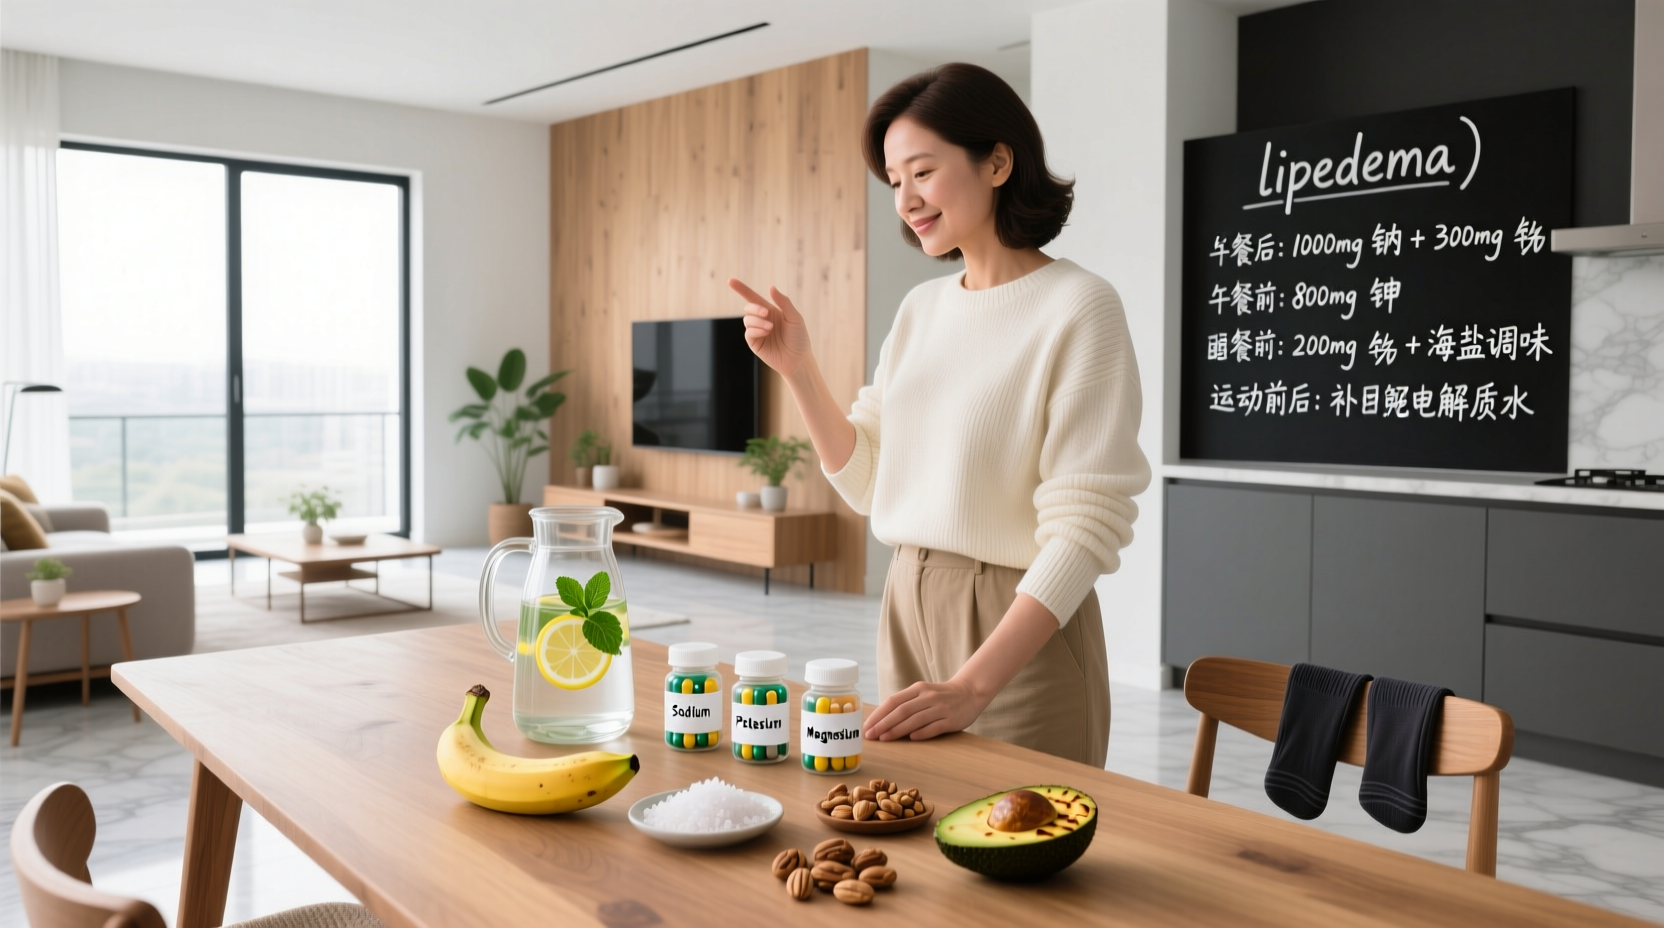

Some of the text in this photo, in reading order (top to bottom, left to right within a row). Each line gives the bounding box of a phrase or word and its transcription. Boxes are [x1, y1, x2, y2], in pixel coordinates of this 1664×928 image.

[1258, 116, 1480, 215] lipedema)
[1292, 233, 1363, 268] 1000mg
[1434, 224, 1504, 261] 300mg
[1291, 282, 1357, 320] 800mg
[1292, 334, 1357, 370] 200mg
[1427, 323, 1554, 362] 海盐调味
[1209, 380, 1320, 416] 运动前后:
